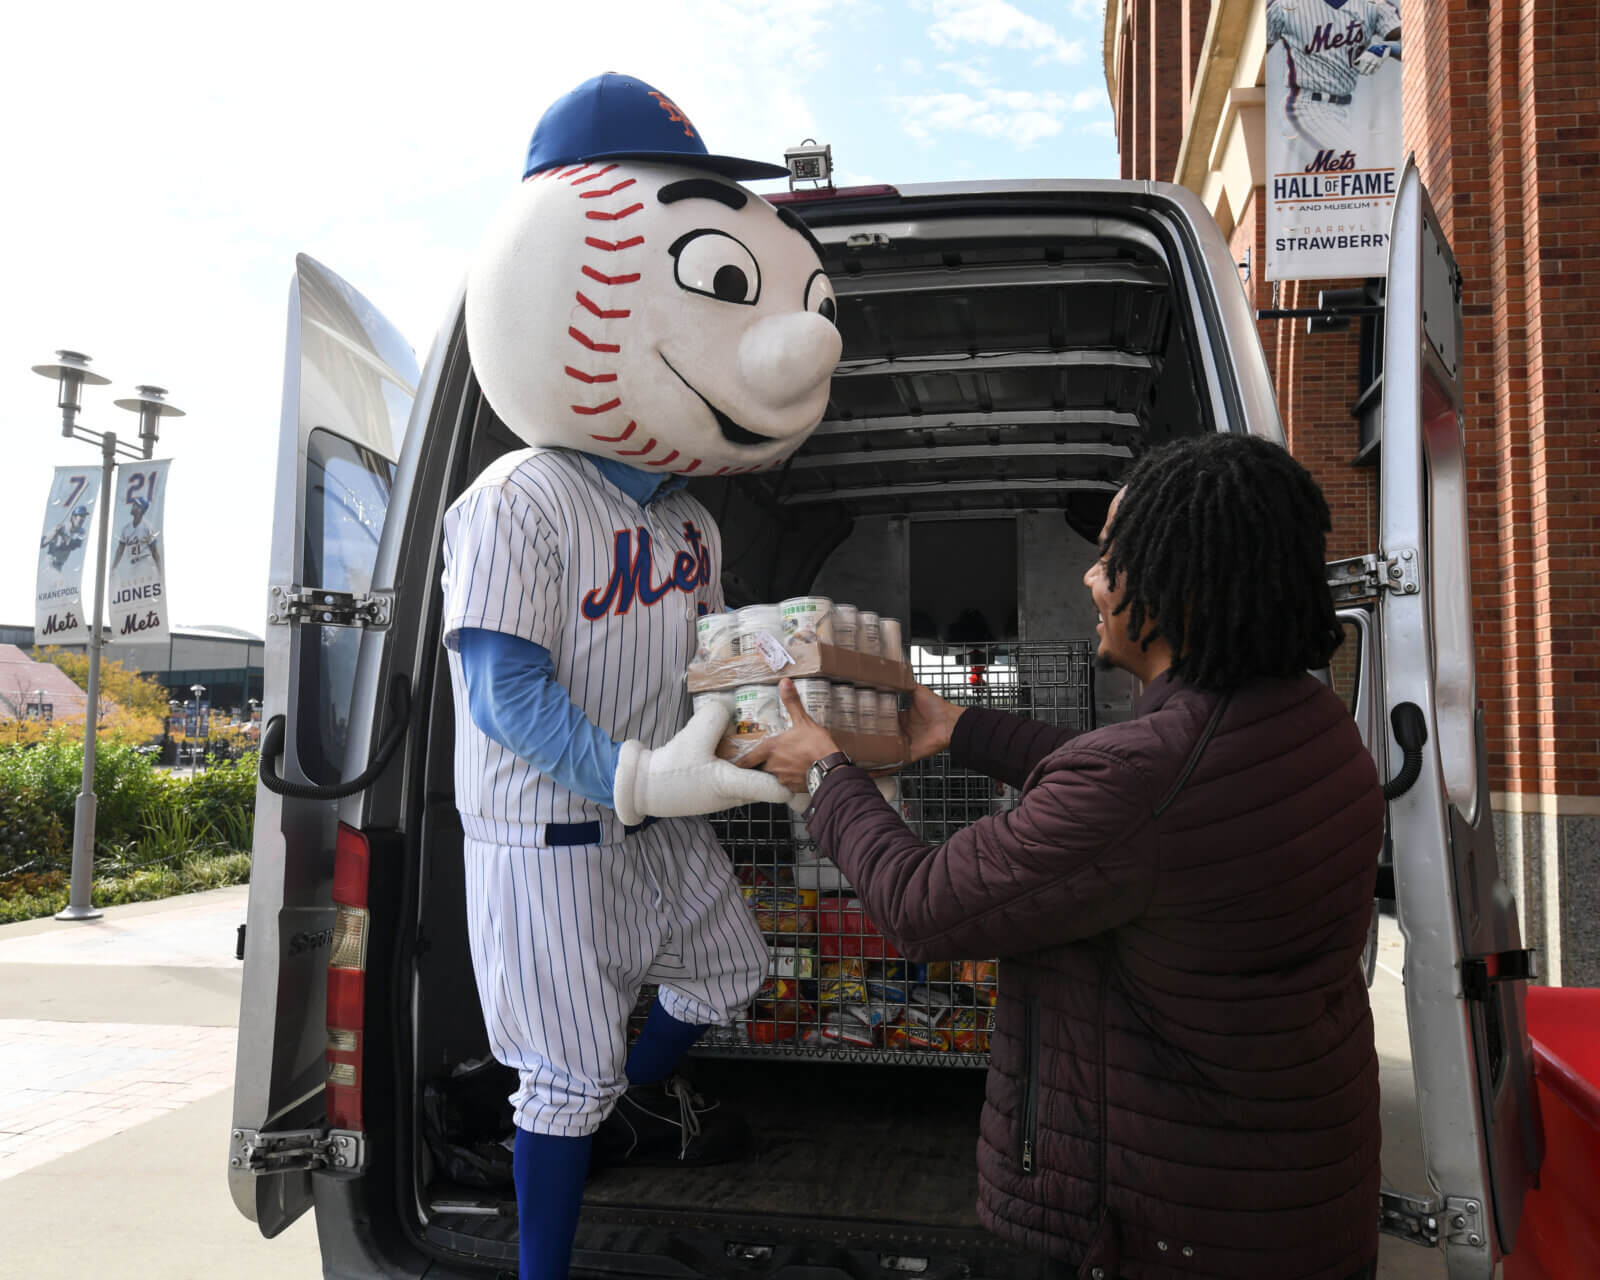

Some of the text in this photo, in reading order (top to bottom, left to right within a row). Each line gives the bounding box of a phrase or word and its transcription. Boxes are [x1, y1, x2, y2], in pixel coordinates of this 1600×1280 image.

[1304, 21, 1364, 55] Mets
[1304, 149, 1356, 172] Mets
[1274, 172, 1395, 199] HALL OF FAME
[1299, 201, 1370, 212] AND MUSEUM
[1303, 223, 1367, 235] DARRYL
[63, 476, 87, 508] 7
[125, 471, 158, 504] 21
[581, 520, 712, 621] Mets
[38, 586, 79, 601] KRANEPOOL
[112, 583, 162, 605] JONES
[42, 611, 78, 636] Mets
[120, 610, 161, 635] Mets
